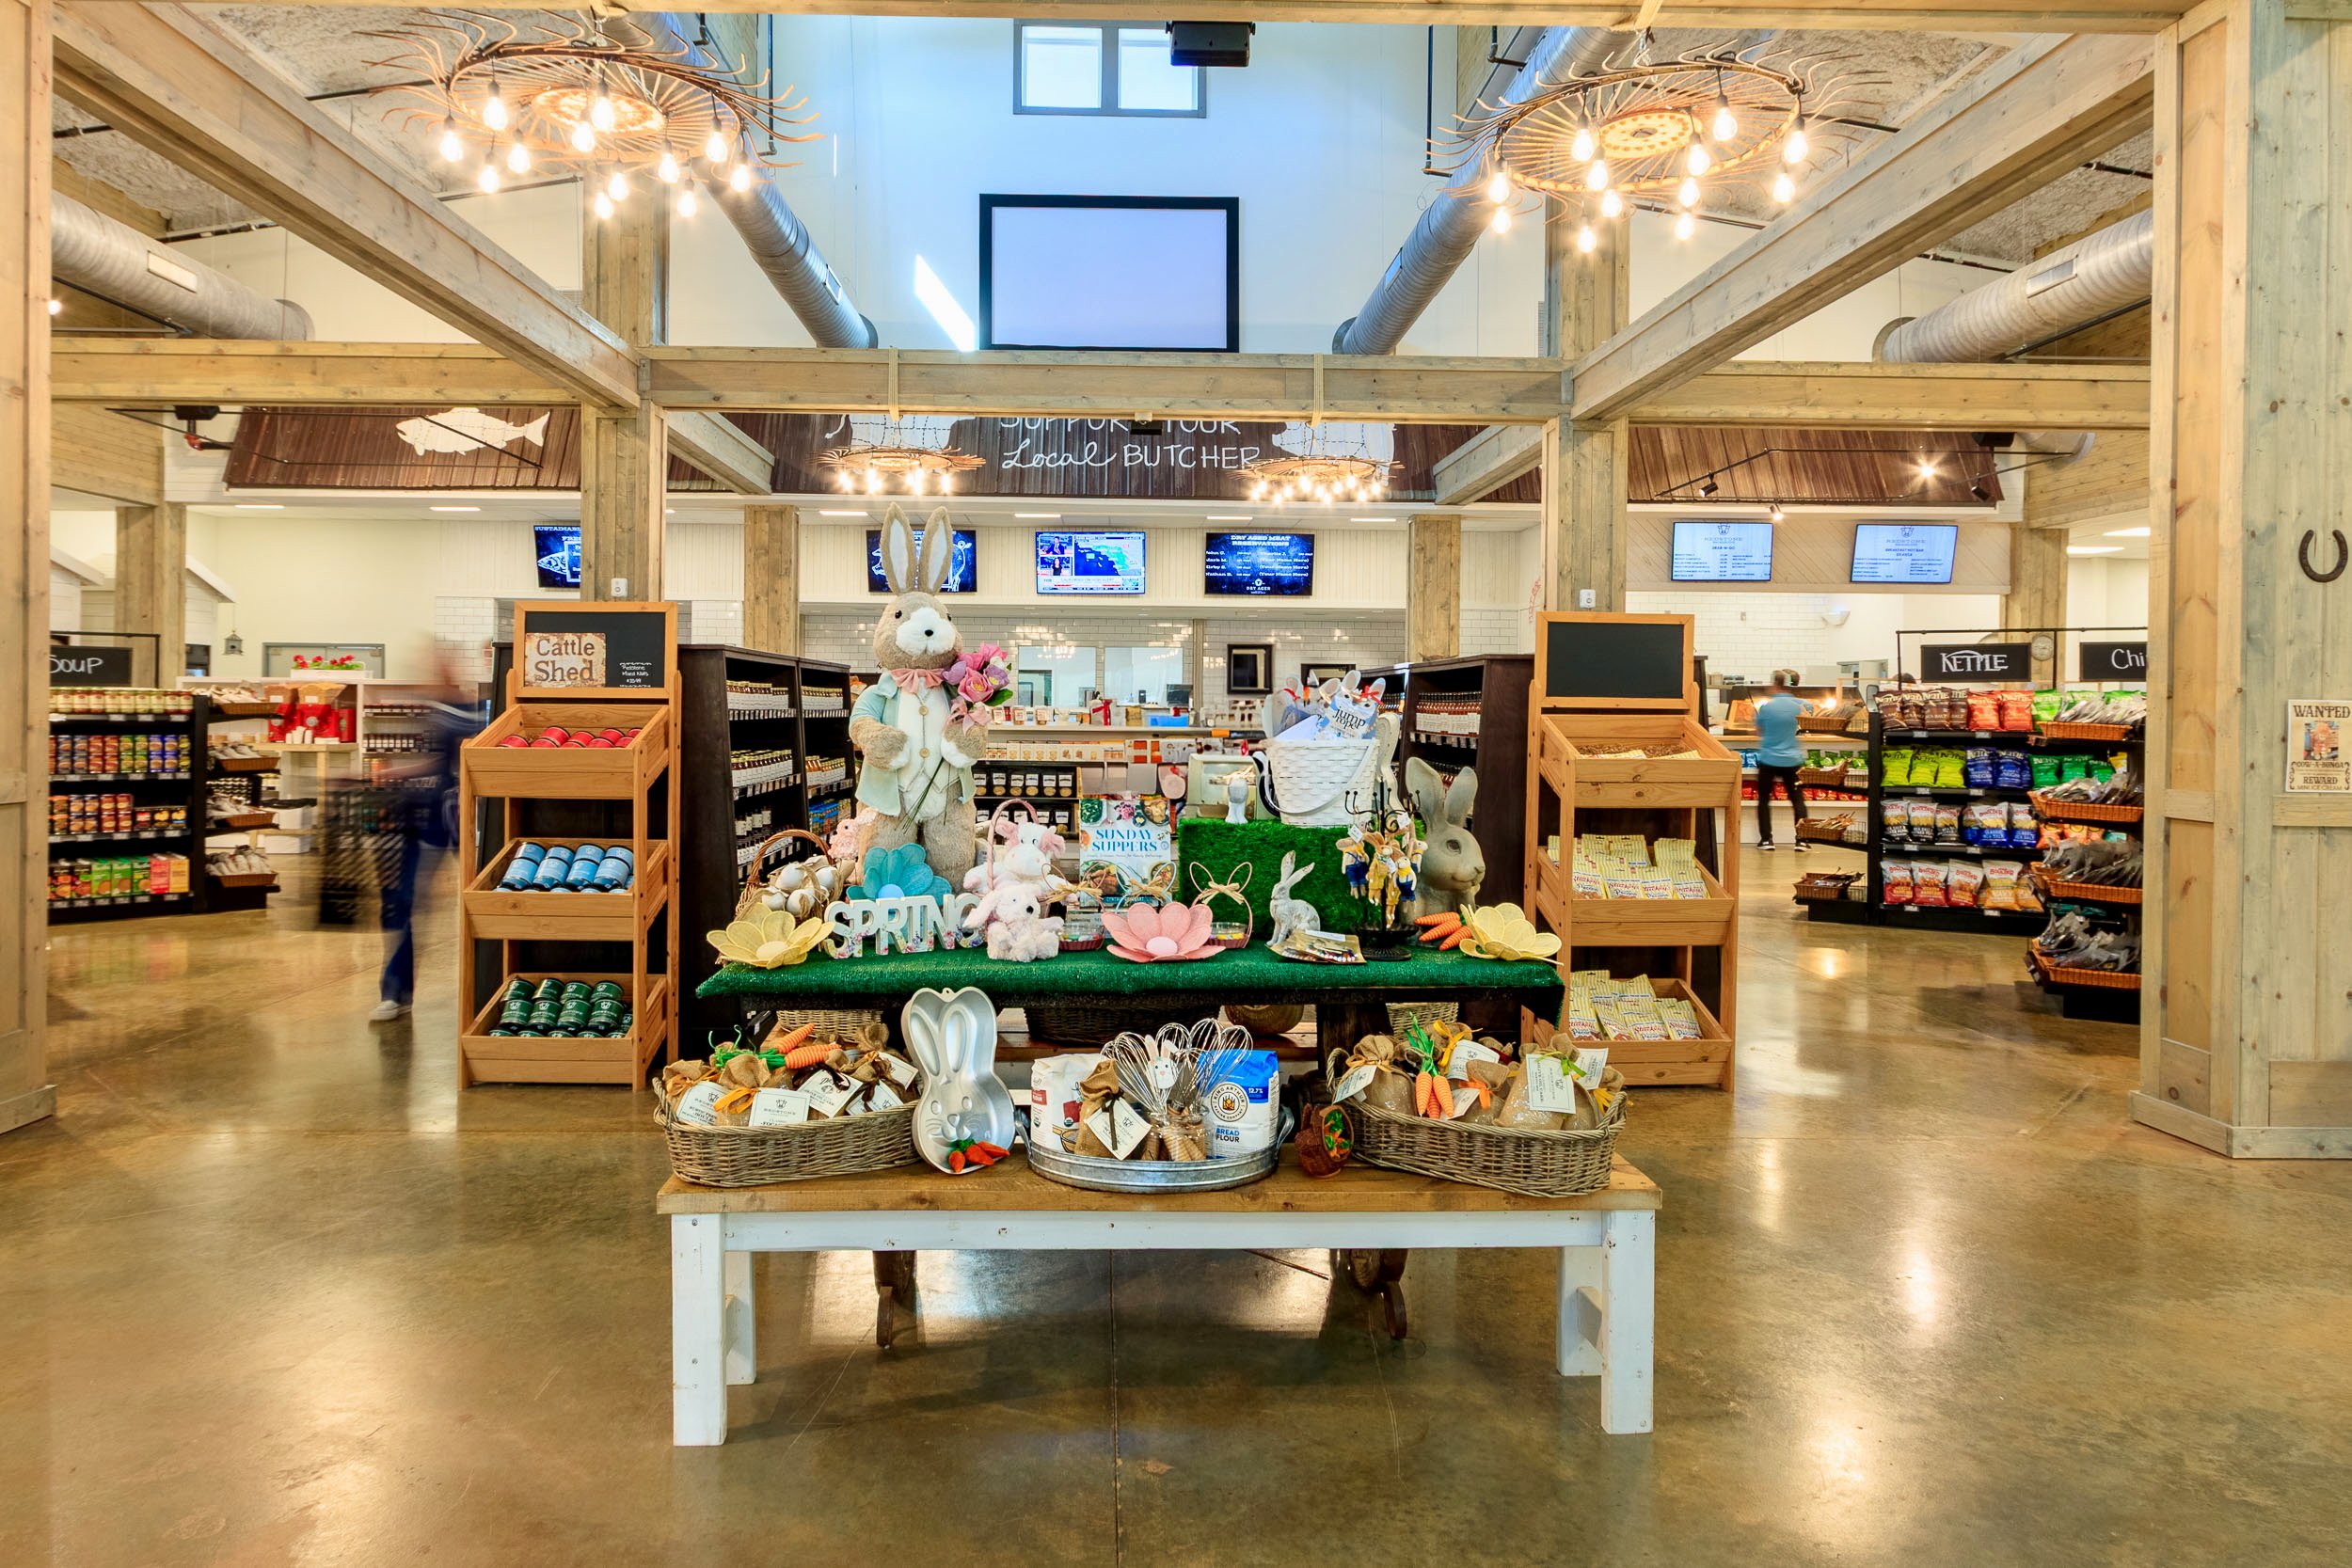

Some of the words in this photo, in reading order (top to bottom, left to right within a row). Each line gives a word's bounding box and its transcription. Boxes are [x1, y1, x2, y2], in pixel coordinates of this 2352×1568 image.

[1001, 437, 1117, 468] Local
[1122, 443, 1261, 470] BUTCHER
[536, 638, 596, 657] Cattle
[1940, 650, 2010, 673] KETTLE
[2111, 648, 2147, 670] Chi
[534, 659, 596, 682] Shed
[1332, 705, 1366, 729] jump
[2293, 705, 2351, 719] WANTED
[2303, 776, 2338, 784] REWARD
[1096, 829, 1152, 840] SUNDAY
[1092, 841, 1157, 852] SUPPERS
[824, 892, 984, 959] SPRING
[1214, 1086, 1225, 1101] KING
[1226, 1086, 1245, 1103] ARTHUR
[1216, 1128, 1240, 1136] BREAD
[1216, 1134, 1240, 1143] FLOUR
